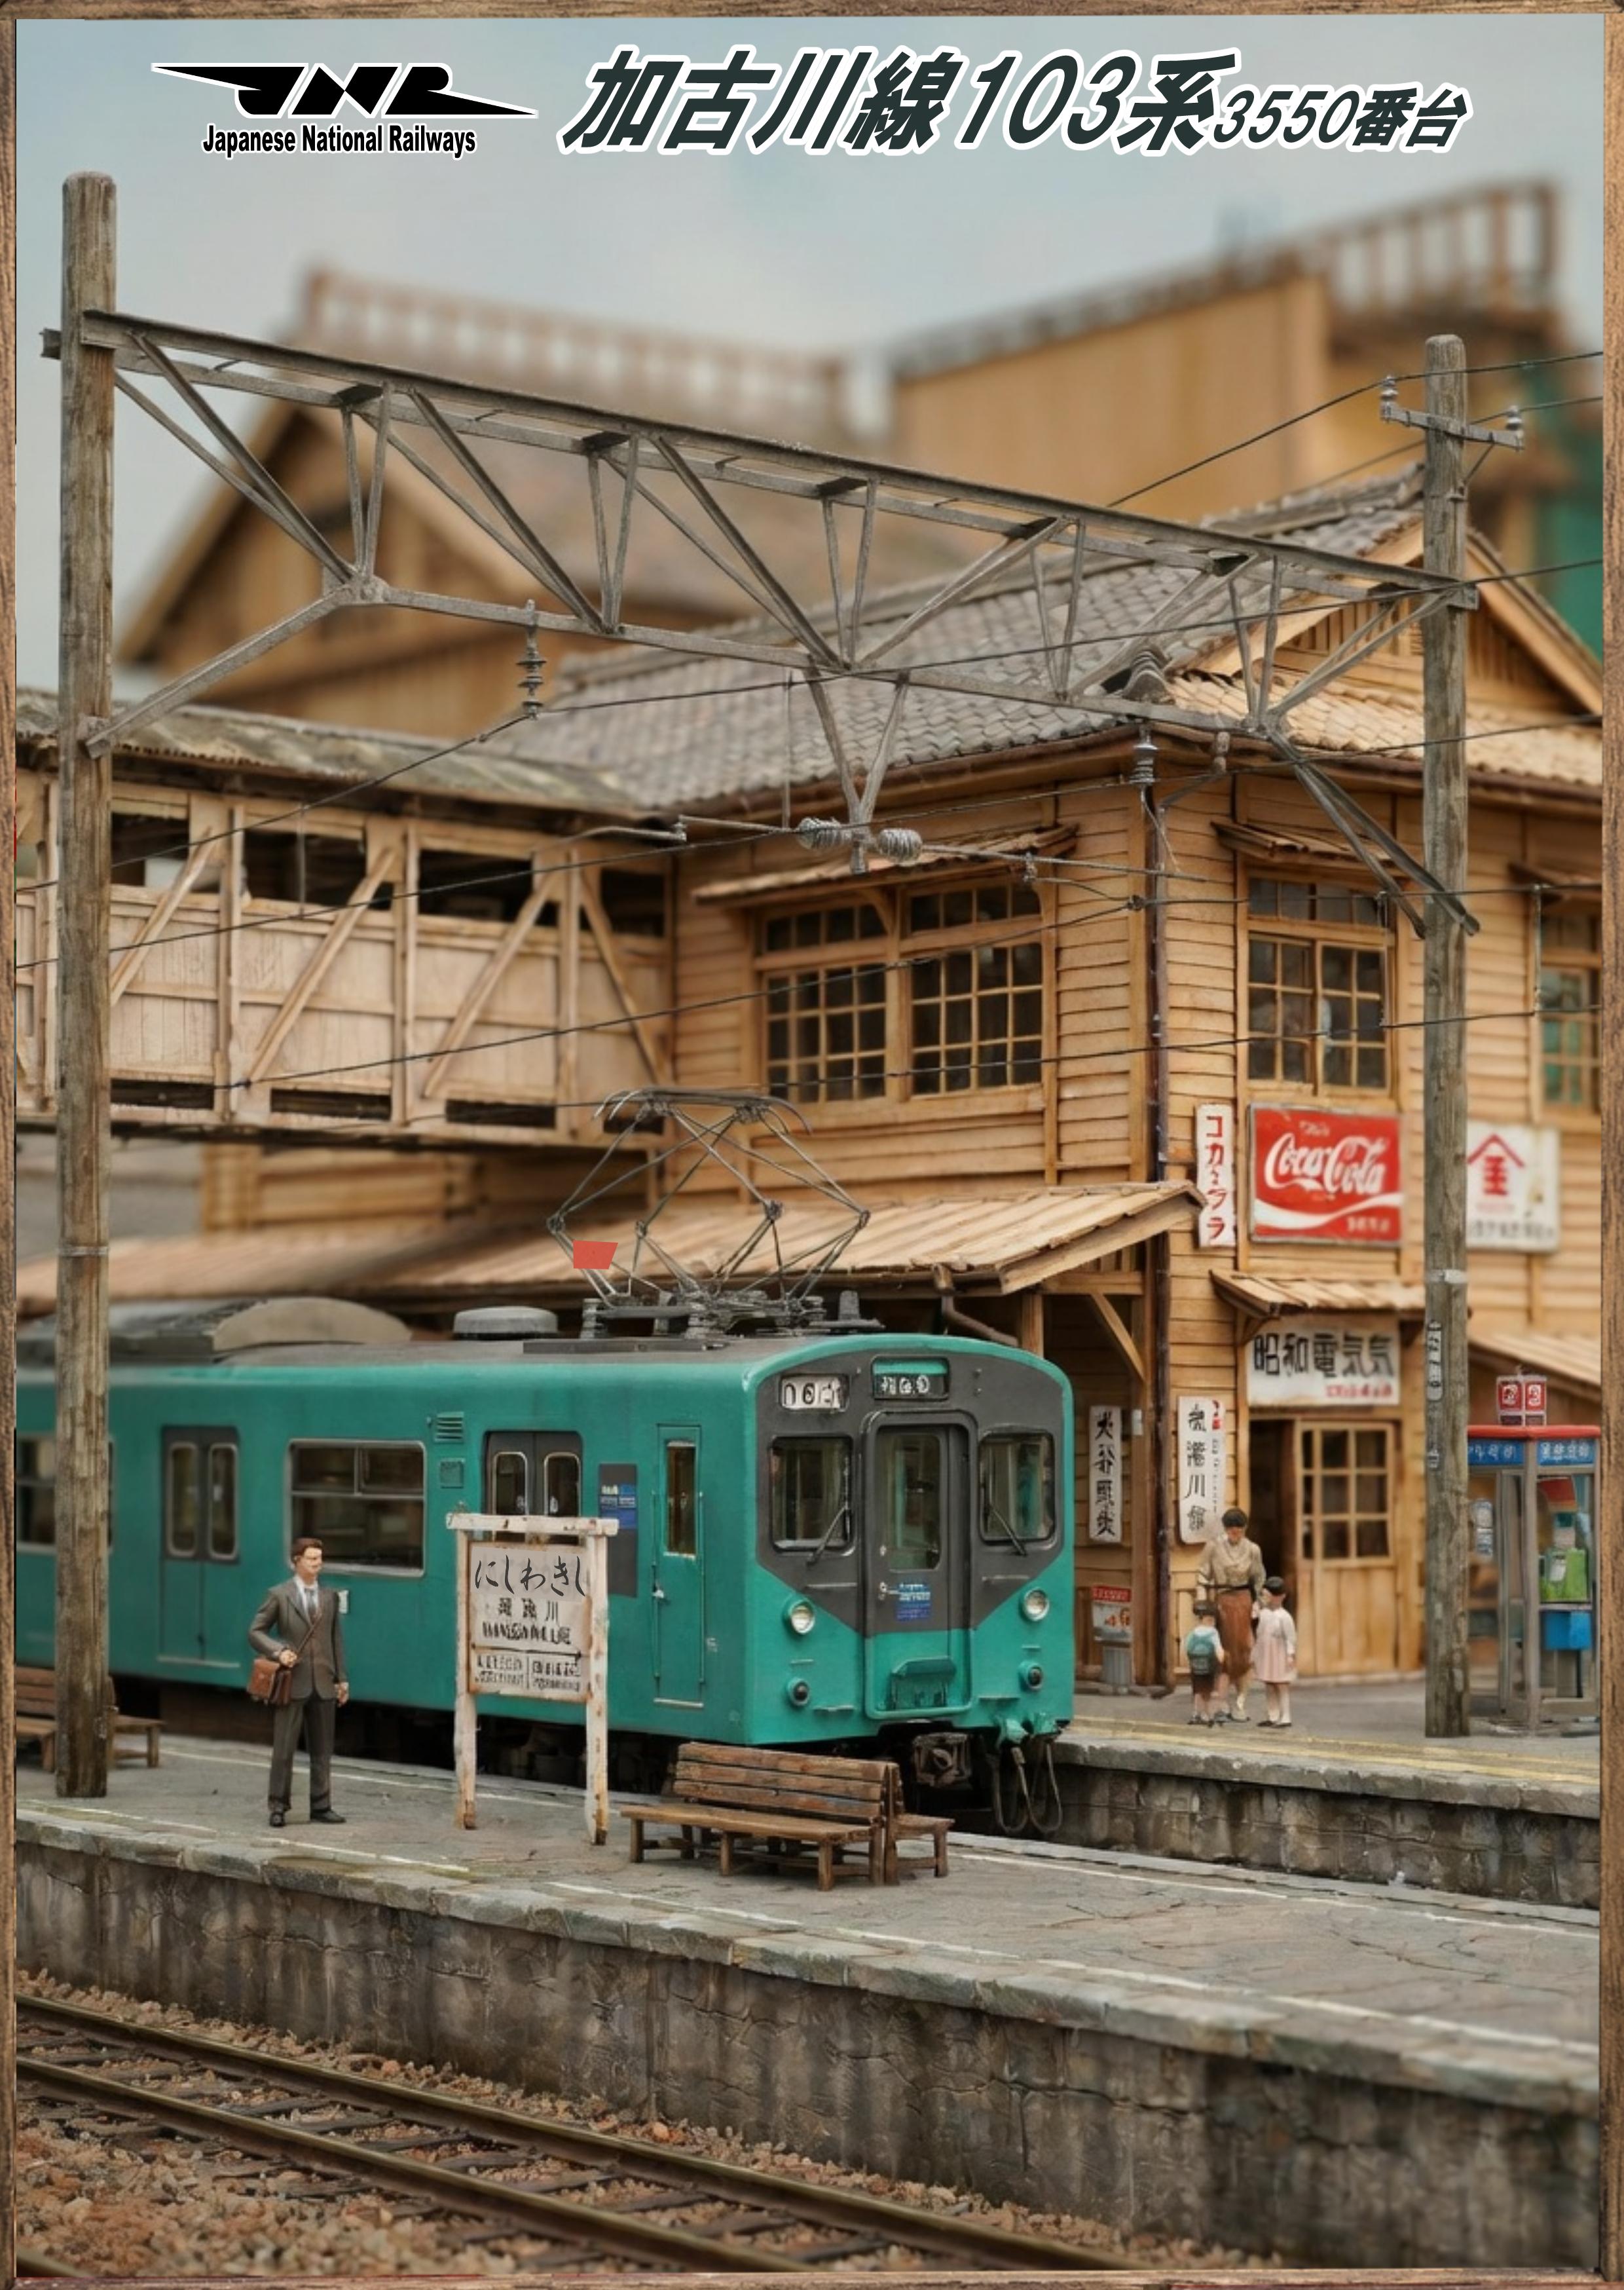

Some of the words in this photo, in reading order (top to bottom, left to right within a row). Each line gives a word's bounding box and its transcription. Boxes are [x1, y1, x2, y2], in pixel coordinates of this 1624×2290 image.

[475, 1554, 585, 1597] にしわきし
